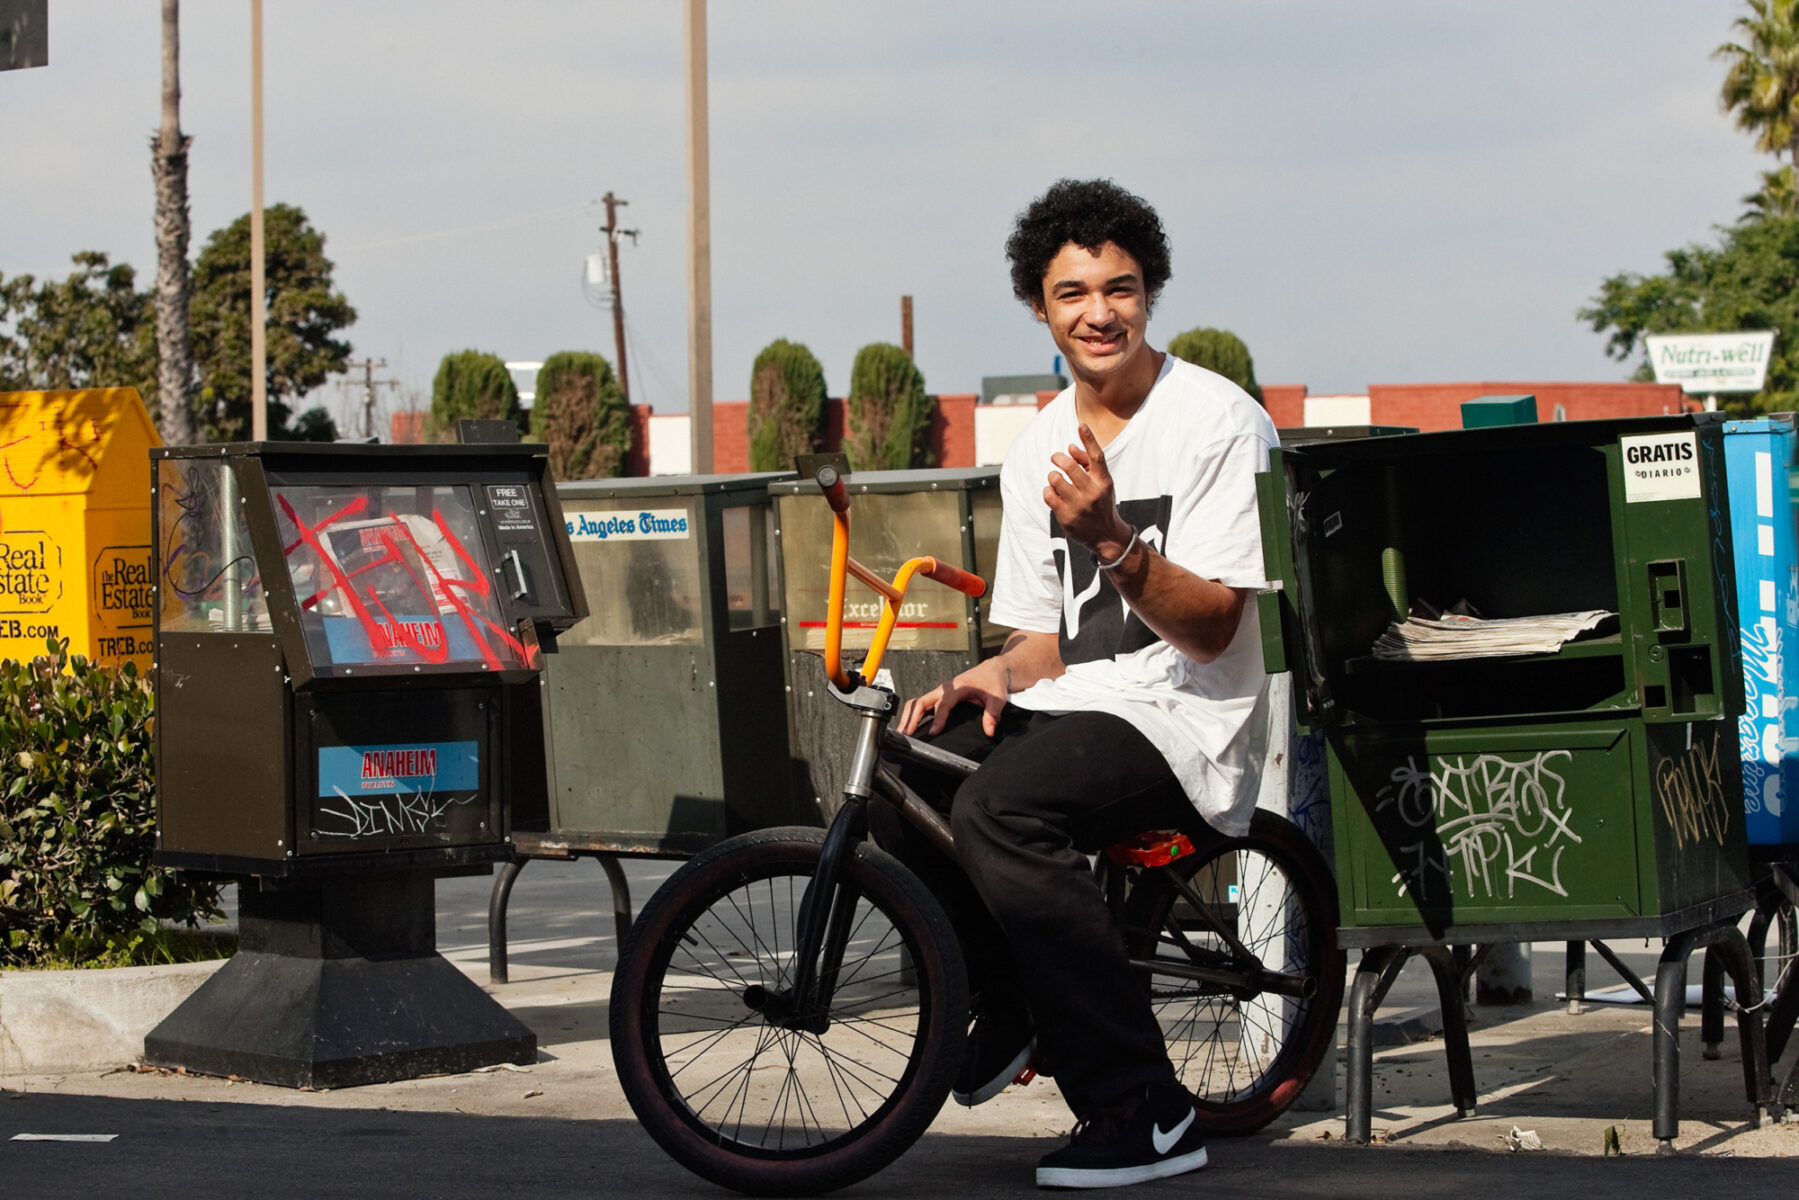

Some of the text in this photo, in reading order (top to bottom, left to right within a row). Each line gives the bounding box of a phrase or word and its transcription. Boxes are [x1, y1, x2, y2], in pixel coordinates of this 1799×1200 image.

[1627, 442, 1693, 464] GRATIS
[1641, 467, 1682, 479] DIARIO
[493, 498, 526, 507] TAKE ONE
[496, 488, 517, 497] FREE
[576, 514, 635, 538] Angeles
[639, 512, 688, 534] Times
[0, 541, 46, 570] Real
[0, 569, 50, 595] state
[113, 555, 152, 586] Real
[19, 593, 44, 605] Book
[102, 582, 152, 610] Estate
[825, 595, 928, 620] xcelor
[0, 619, 59, 639] EB.COM
[97, 636, 153, 657] TREB.CO
[361, 749, 437, 779] ANAHEIM
